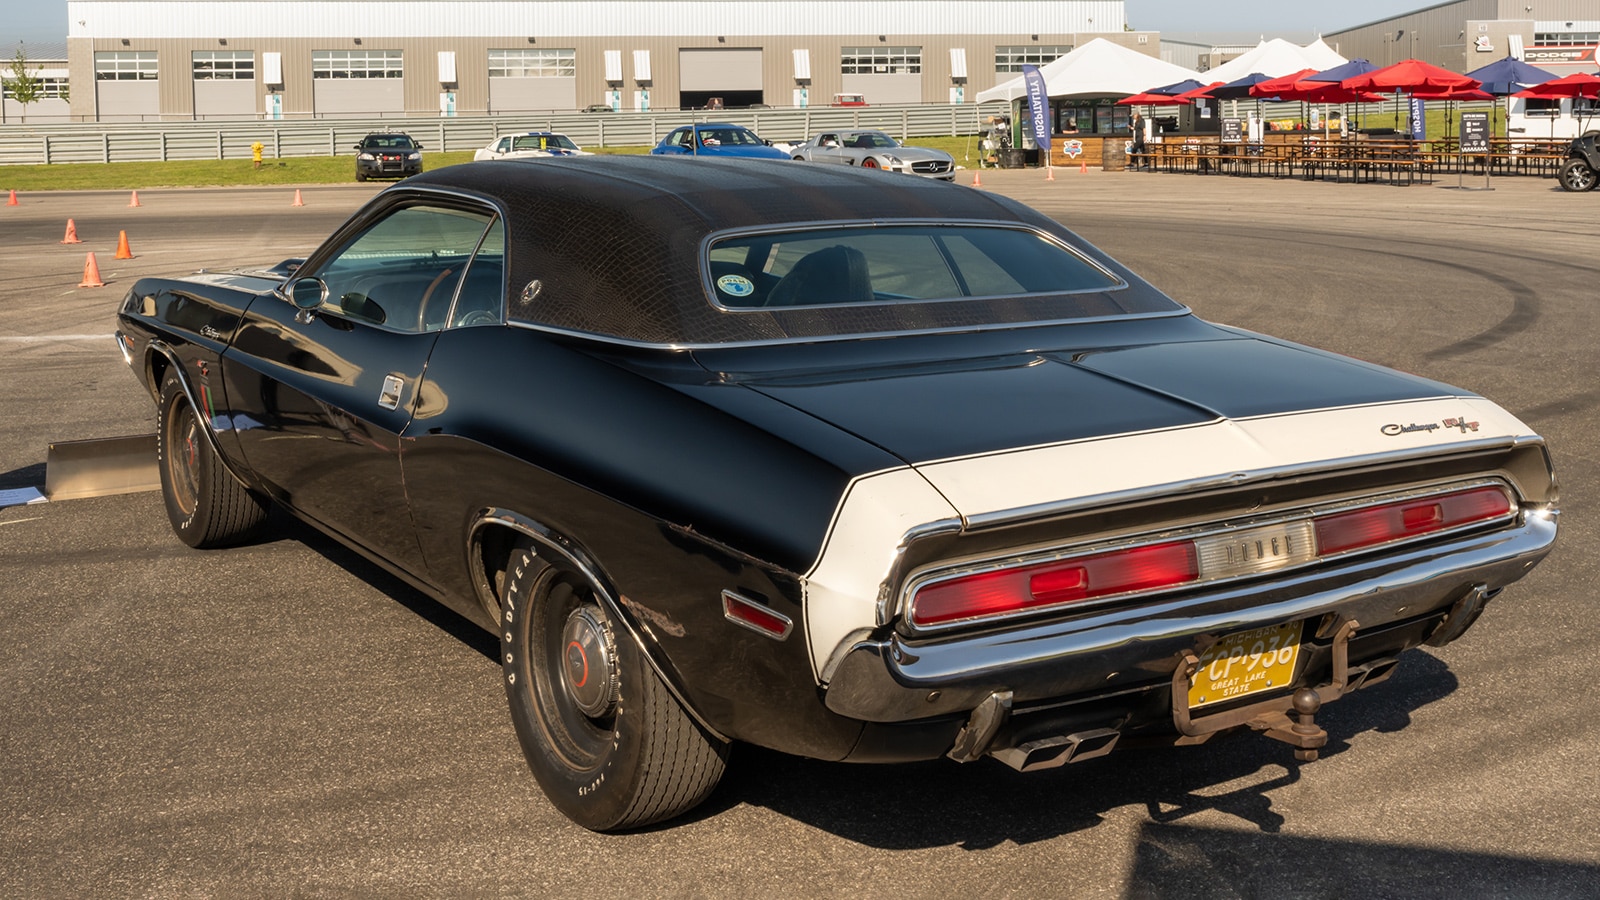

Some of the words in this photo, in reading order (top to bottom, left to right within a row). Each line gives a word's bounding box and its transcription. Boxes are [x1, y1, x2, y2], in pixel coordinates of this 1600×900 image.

[1380, 423, 1440, 436] Challenger
[1226, 535, 1293, 565] DODGE
[505, 545, 537, 685] GOODYEAR
[1225, 626, 1278, 646] MICHIGAN
[1287, 621, 1299, 630] 70
[1211, 677, 1239, 691] GREAT
[1245, 670, 1267, 683] LAKE
[1223, 684, 1250, 697] STATE
